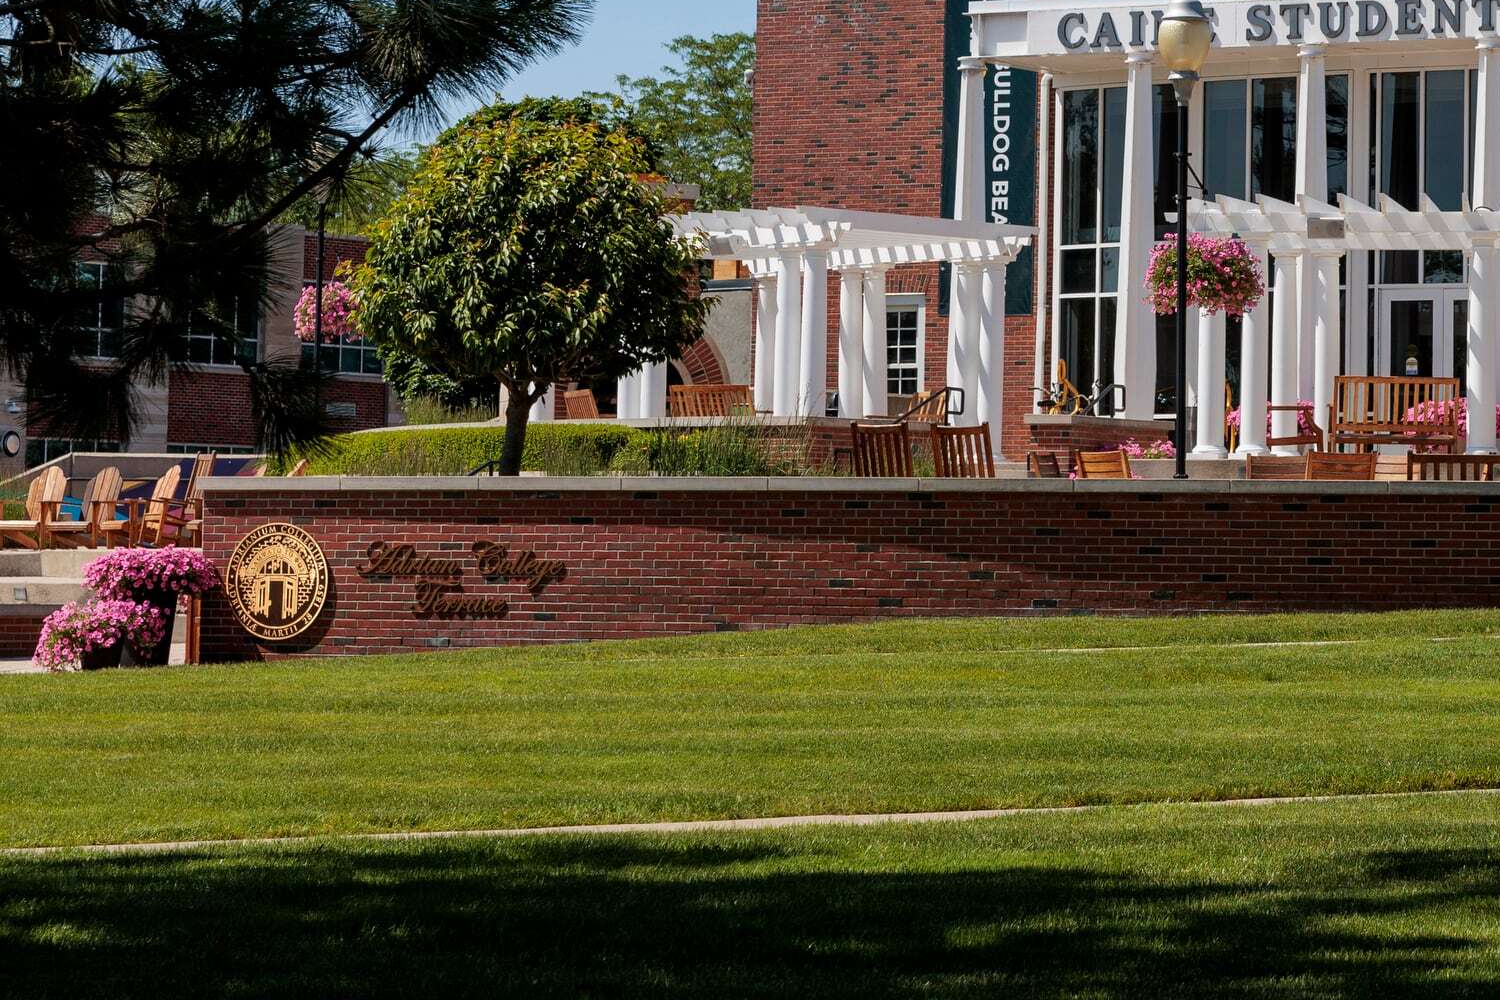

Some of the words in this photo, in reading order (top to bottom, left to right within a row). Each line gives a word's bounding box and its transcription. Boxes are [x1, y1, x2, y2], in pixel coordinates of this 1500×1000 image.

[1057, 8, 1215, 49] CAI
[991, 180, 1009, 224] BEA
[232, 525, 277, 571] ADRIANIUM
[280, 525, 324, 571] COLLEGIUM
[356, 540, 459, 576] Adrian
[471, 540, 564, 589] College
[412, 579, 507, 614] Terrace
[263, 624, 298, 637] MARTII
